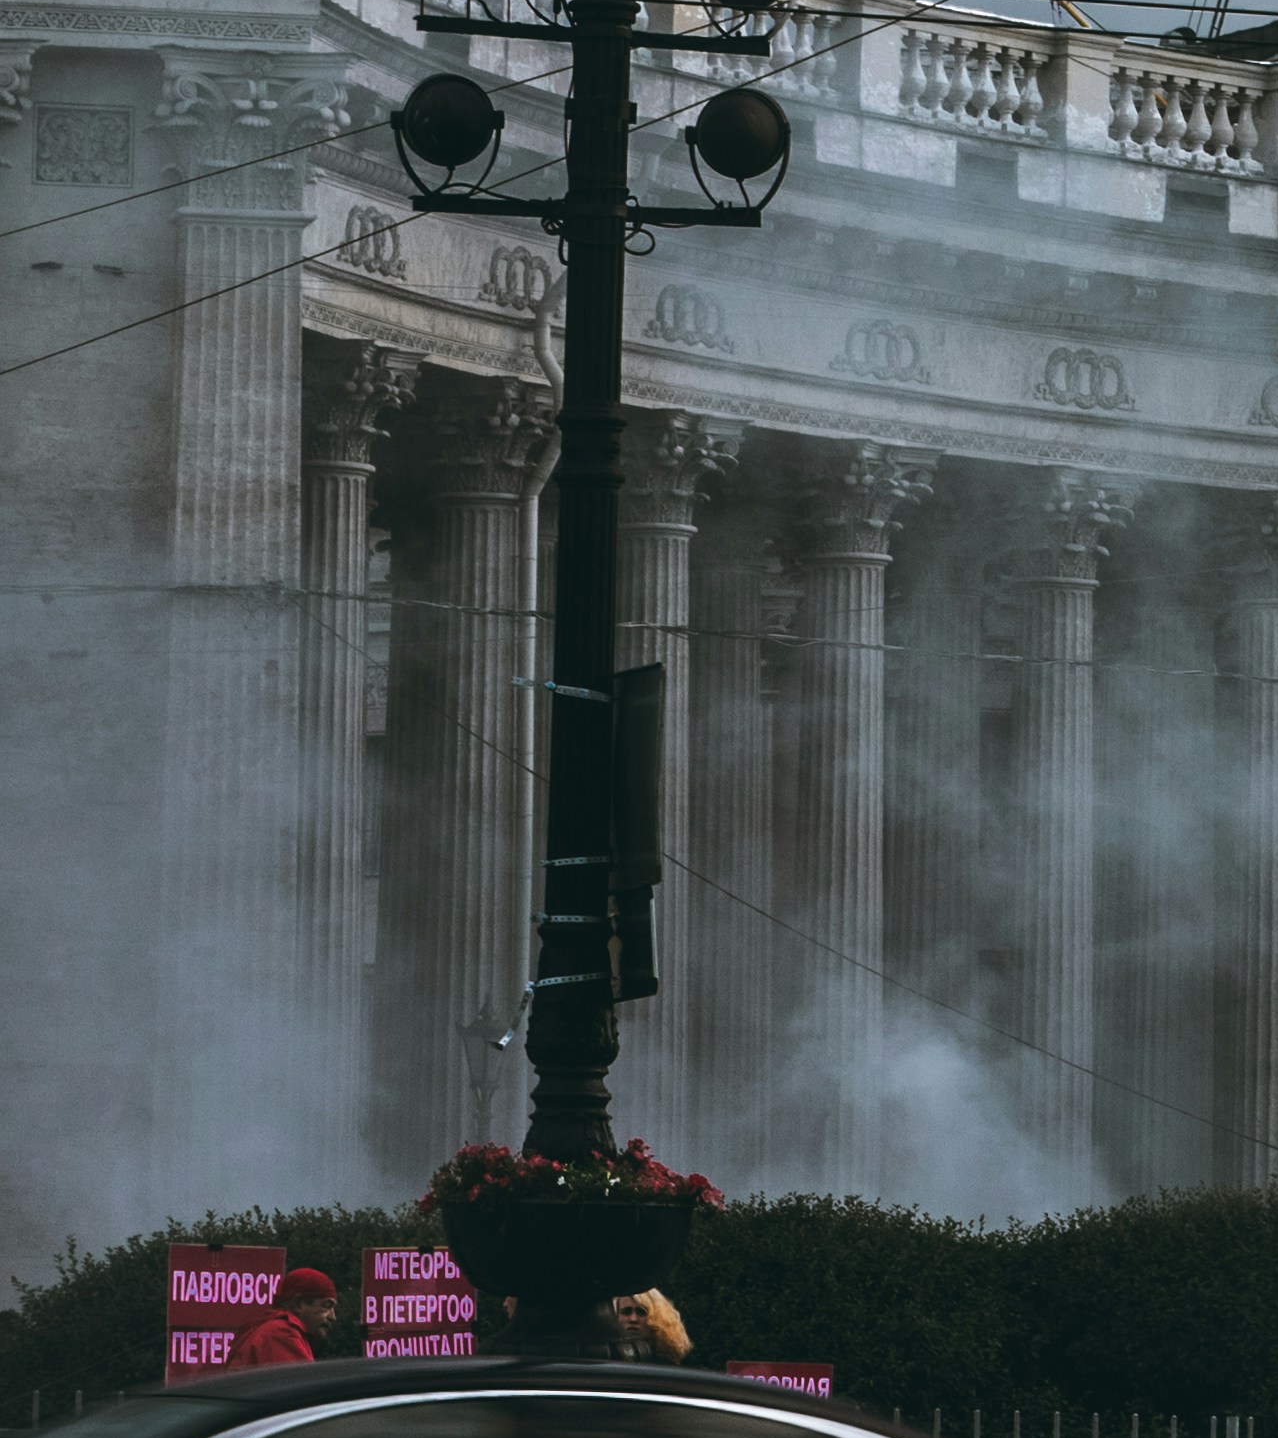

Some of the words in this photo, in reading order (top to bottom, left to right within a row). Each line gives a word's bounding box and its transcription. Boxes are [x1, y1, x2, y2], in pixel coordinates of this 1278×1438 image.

[374, 1251, 460, 1280] МЕТЕОРЫ
[172, 1270, 281, 1305] ПАВЛОВСК
[366, 1295, 378, 1324] В
[382, 1294, 474, 1323] ПЕТЕРГОФ
